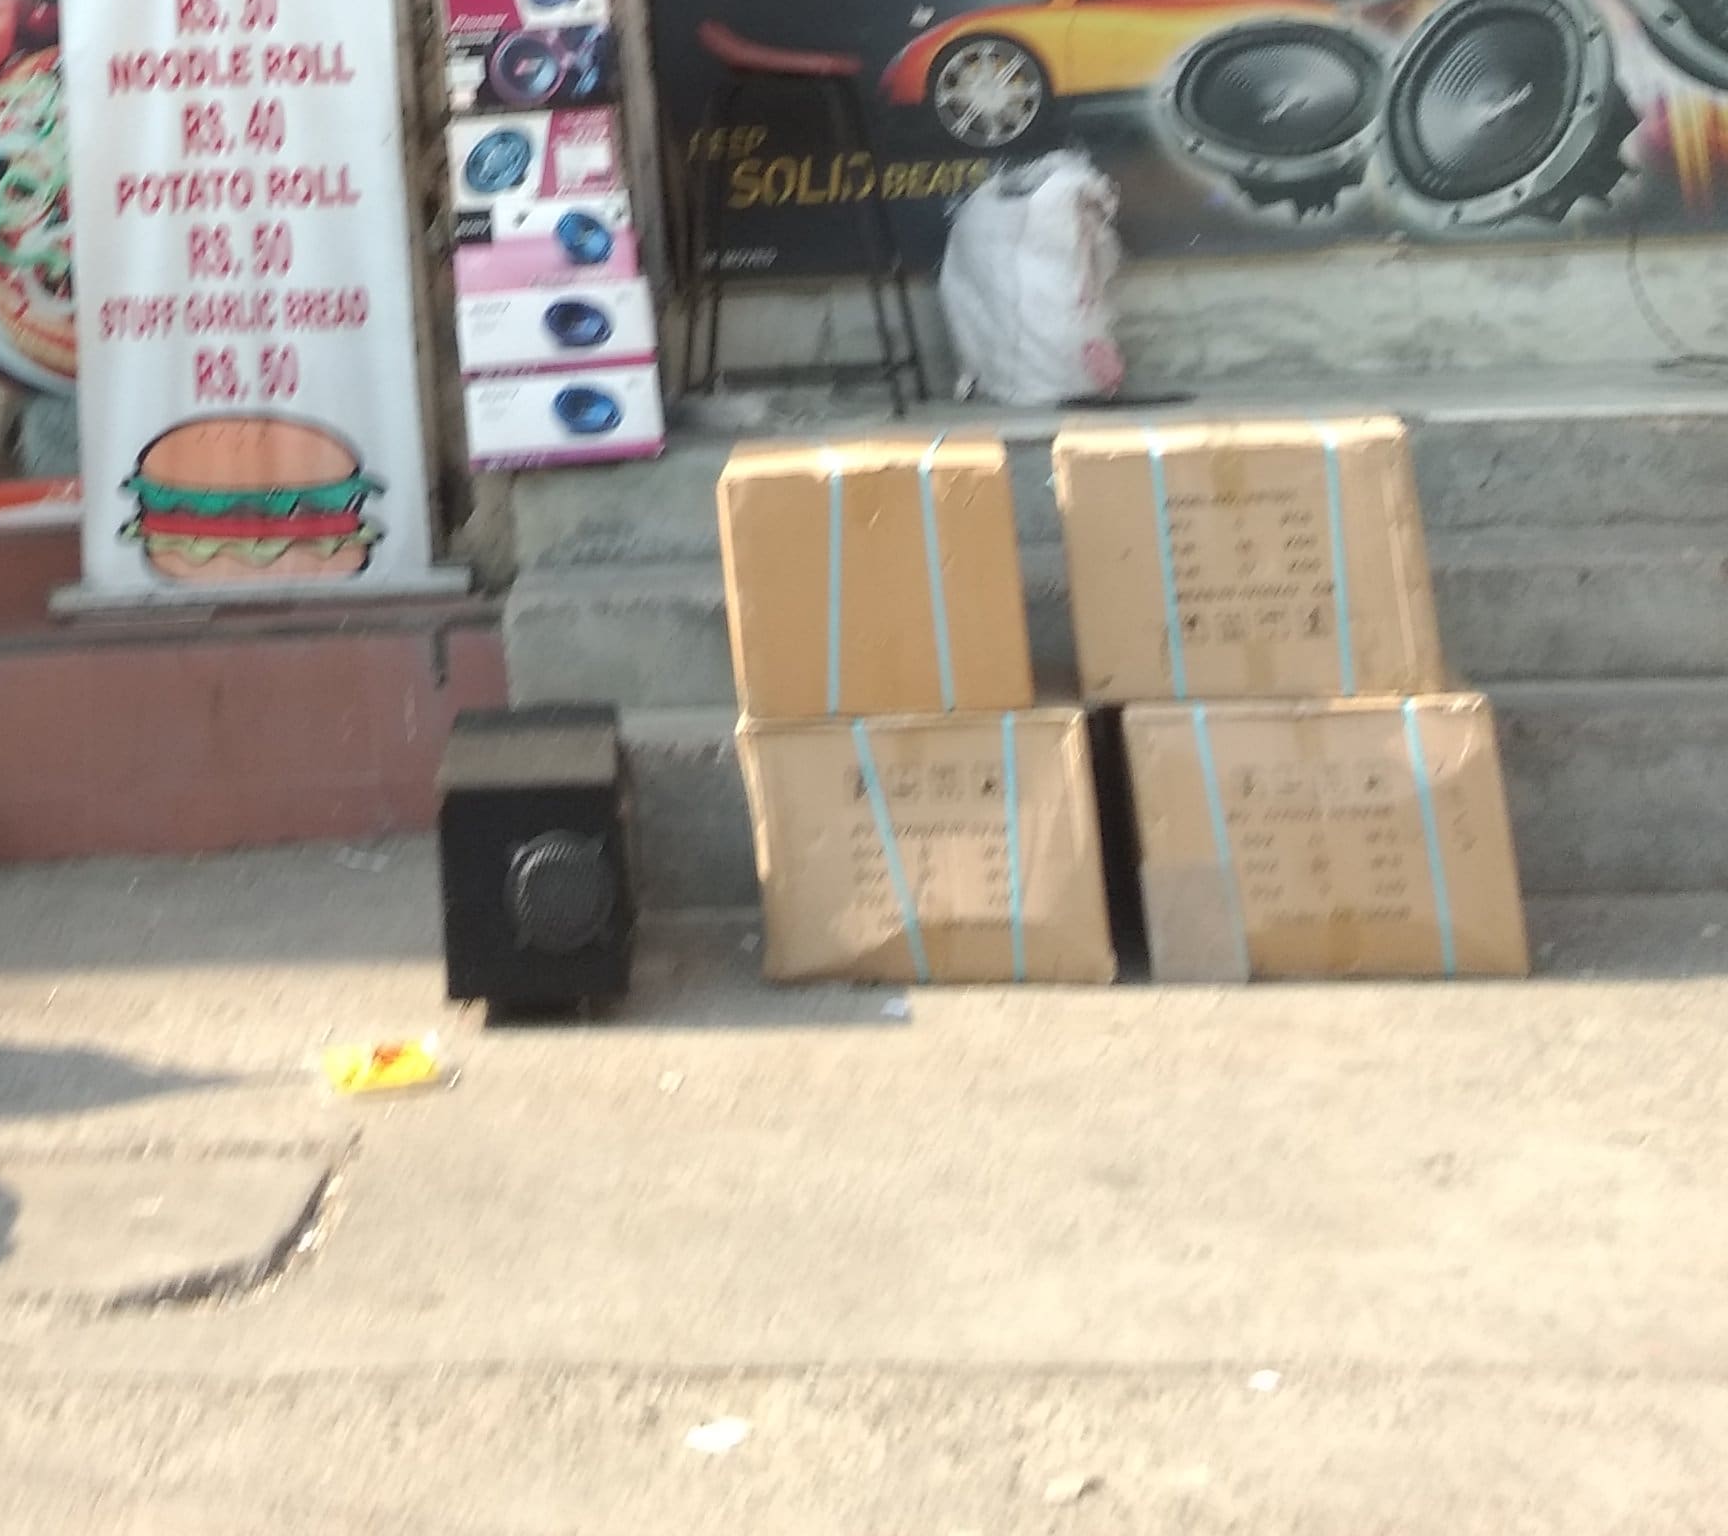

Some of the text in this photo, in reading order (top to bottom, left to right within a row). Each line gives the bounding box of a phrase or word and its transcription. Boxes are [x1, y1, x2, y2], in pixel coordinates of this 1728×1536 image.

[108, 42, 355, 96] NOODLE ROLL
[245, 97, 287, 155] 40
[115, 163, 361, 218] POTATO ROLL
[727, 151, 876, 209] SOLID
[184, 289, 276, 336] GARLIC
[282, 286, 370, 332] BREAD
